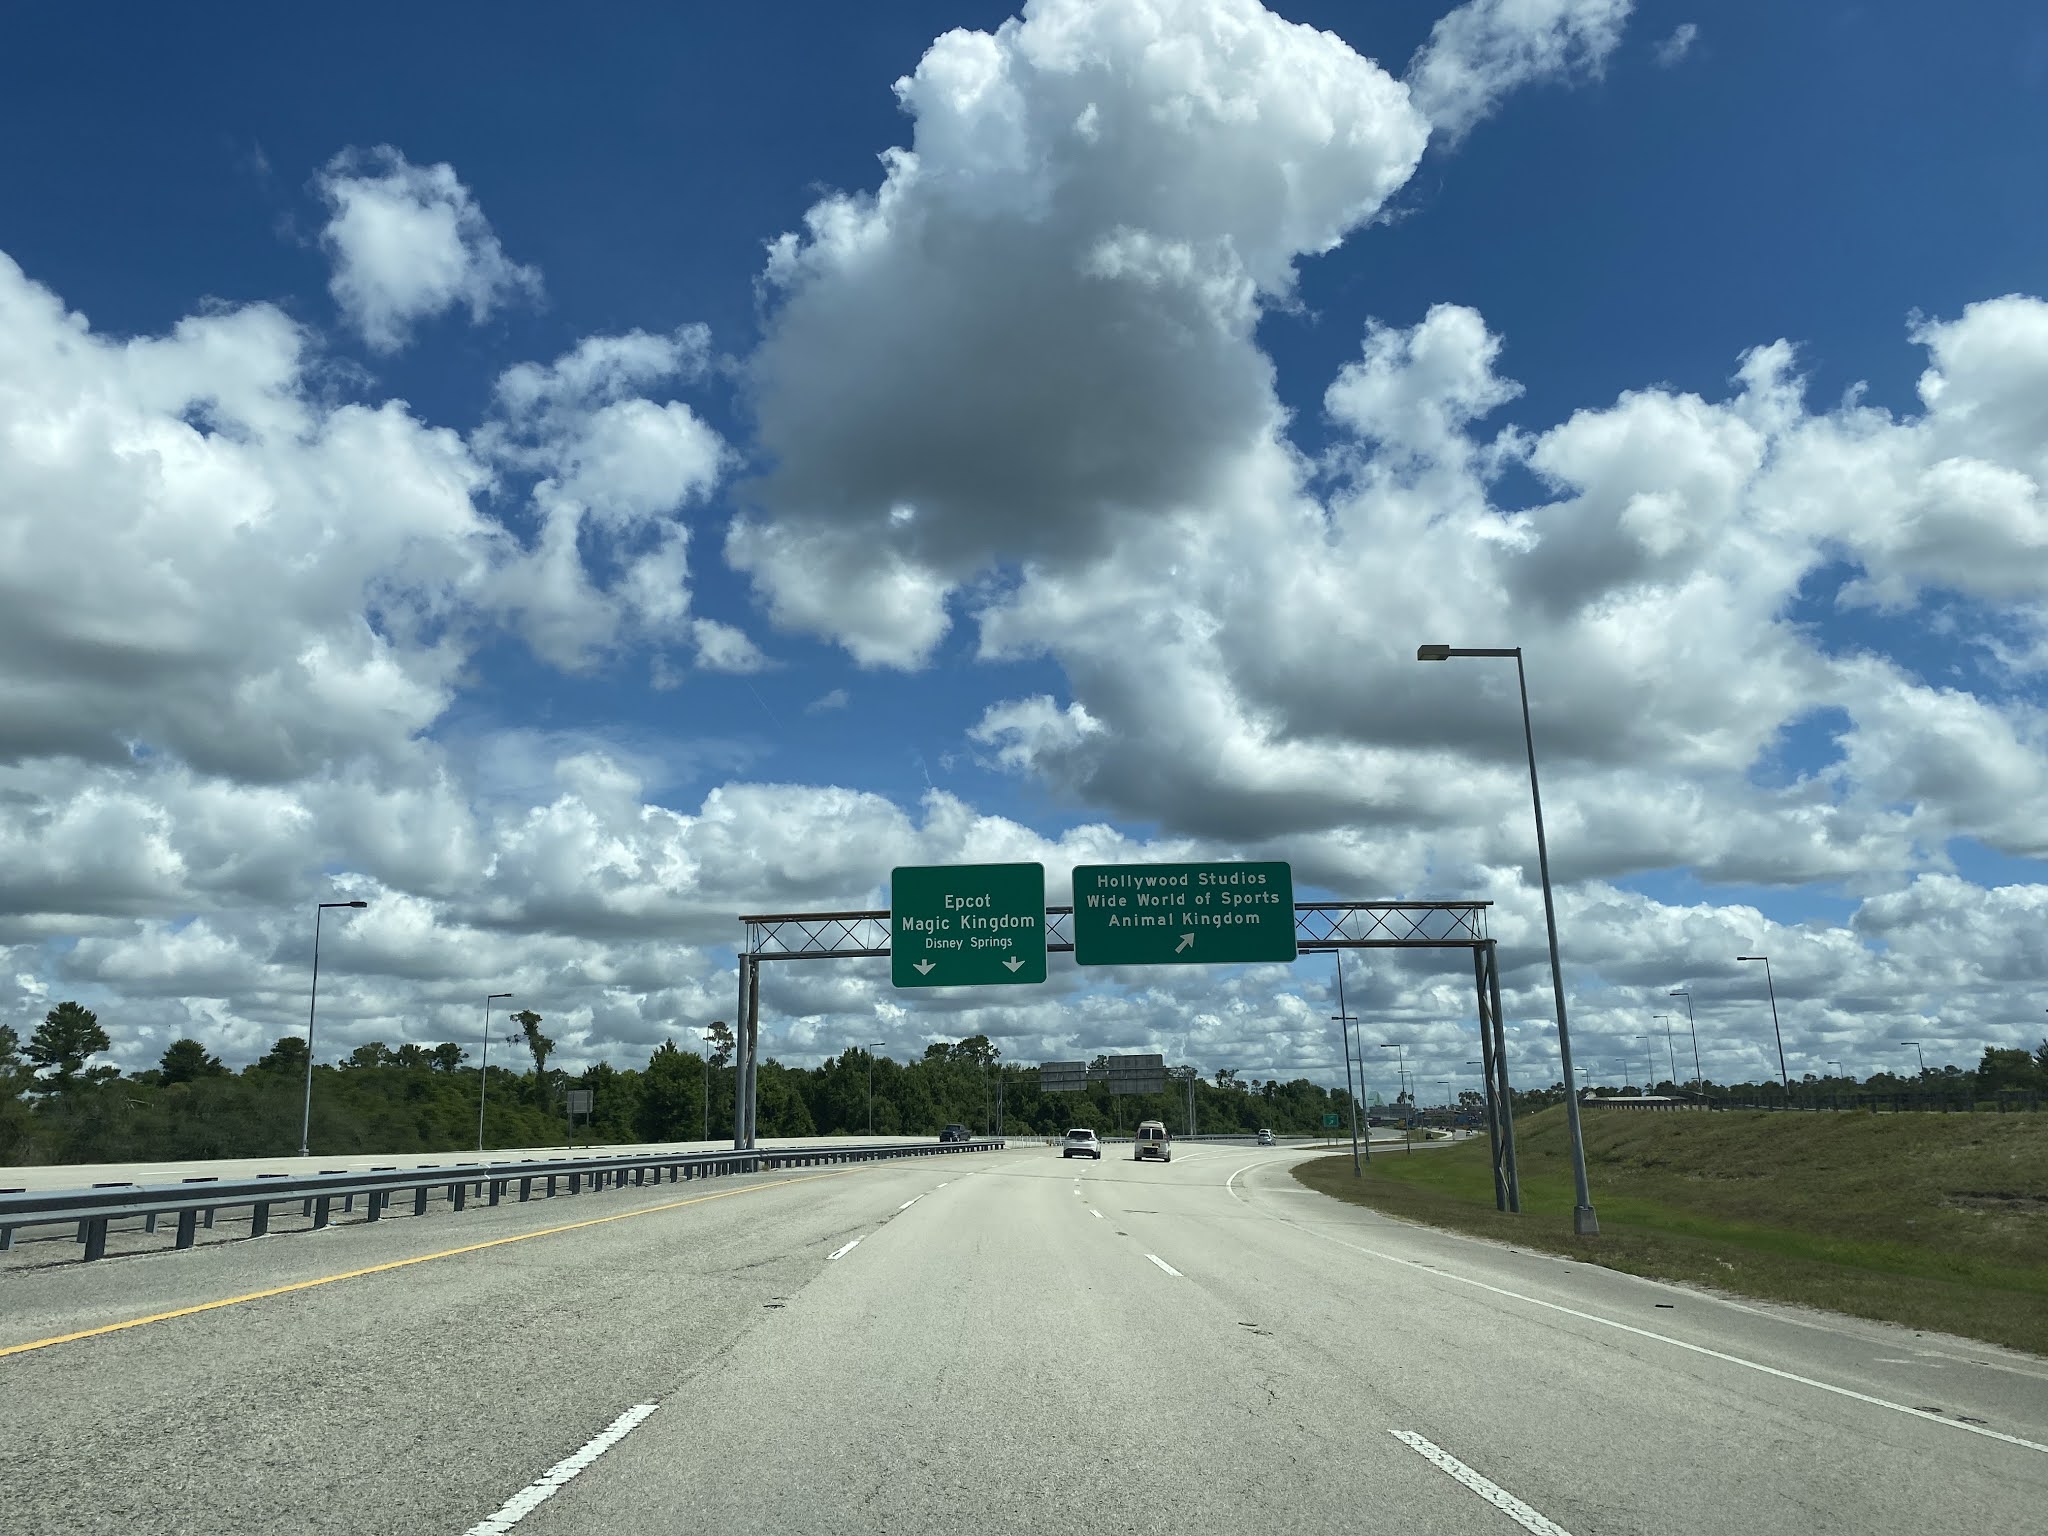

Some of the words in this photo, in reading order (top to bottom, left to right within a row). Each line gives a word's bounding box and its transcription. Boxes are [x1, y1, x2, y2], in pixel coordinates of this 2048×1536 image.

[1097, 873, 1188, 890] Hollywood
[1198, 871, 1266, 885] Studios
[945, 893, 991, 911] Epcot
[1087, 894, 1127, 908] Wide
[1137, 893, 1185, 907] World
[1195, 892, 1211, 905] of
[1221, 891, 1280, 907] Sports
[902, 915, 950, 935] Magic
[960, 913, 1035, 933] Kingdom
[1108, 912, 1173, 927] Animal
[1182, 911, 1260, 928] Kingdom
[925, 937, 963, 951] Disney
[970, 936, 1013, 950] Springs
